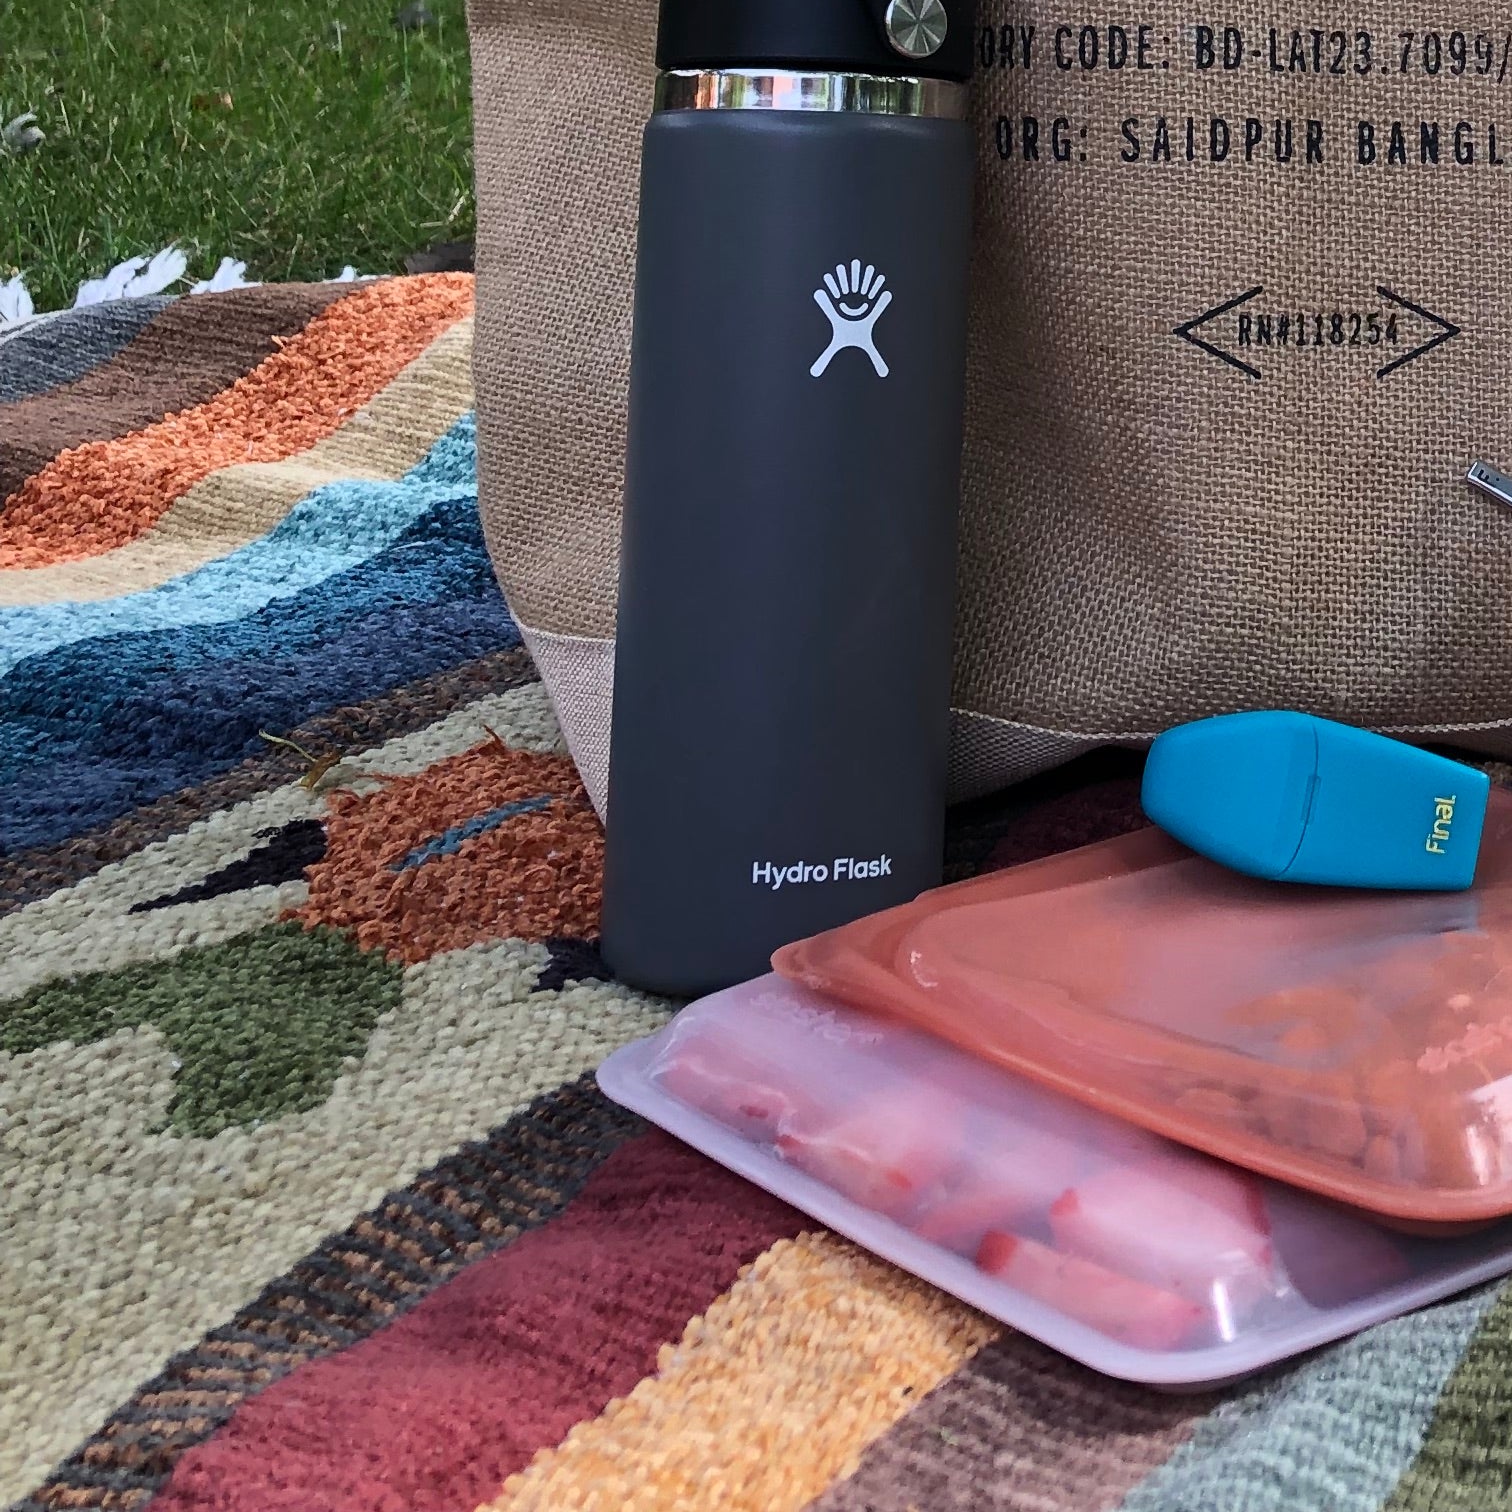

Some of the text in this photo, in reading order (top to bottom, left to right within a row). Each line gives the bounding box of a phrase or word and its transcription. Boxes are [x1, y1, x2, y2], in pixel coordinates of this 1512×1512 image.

[1054, 24, 1170, 71] CODE:
[995, 117, 1088, 162] ORG:
[1121, 117, 1324, 164] SAIDPUR
[1237, 312, 1398, 347] RN#118254
[752, 854, 892, 890] Hydro Flask
